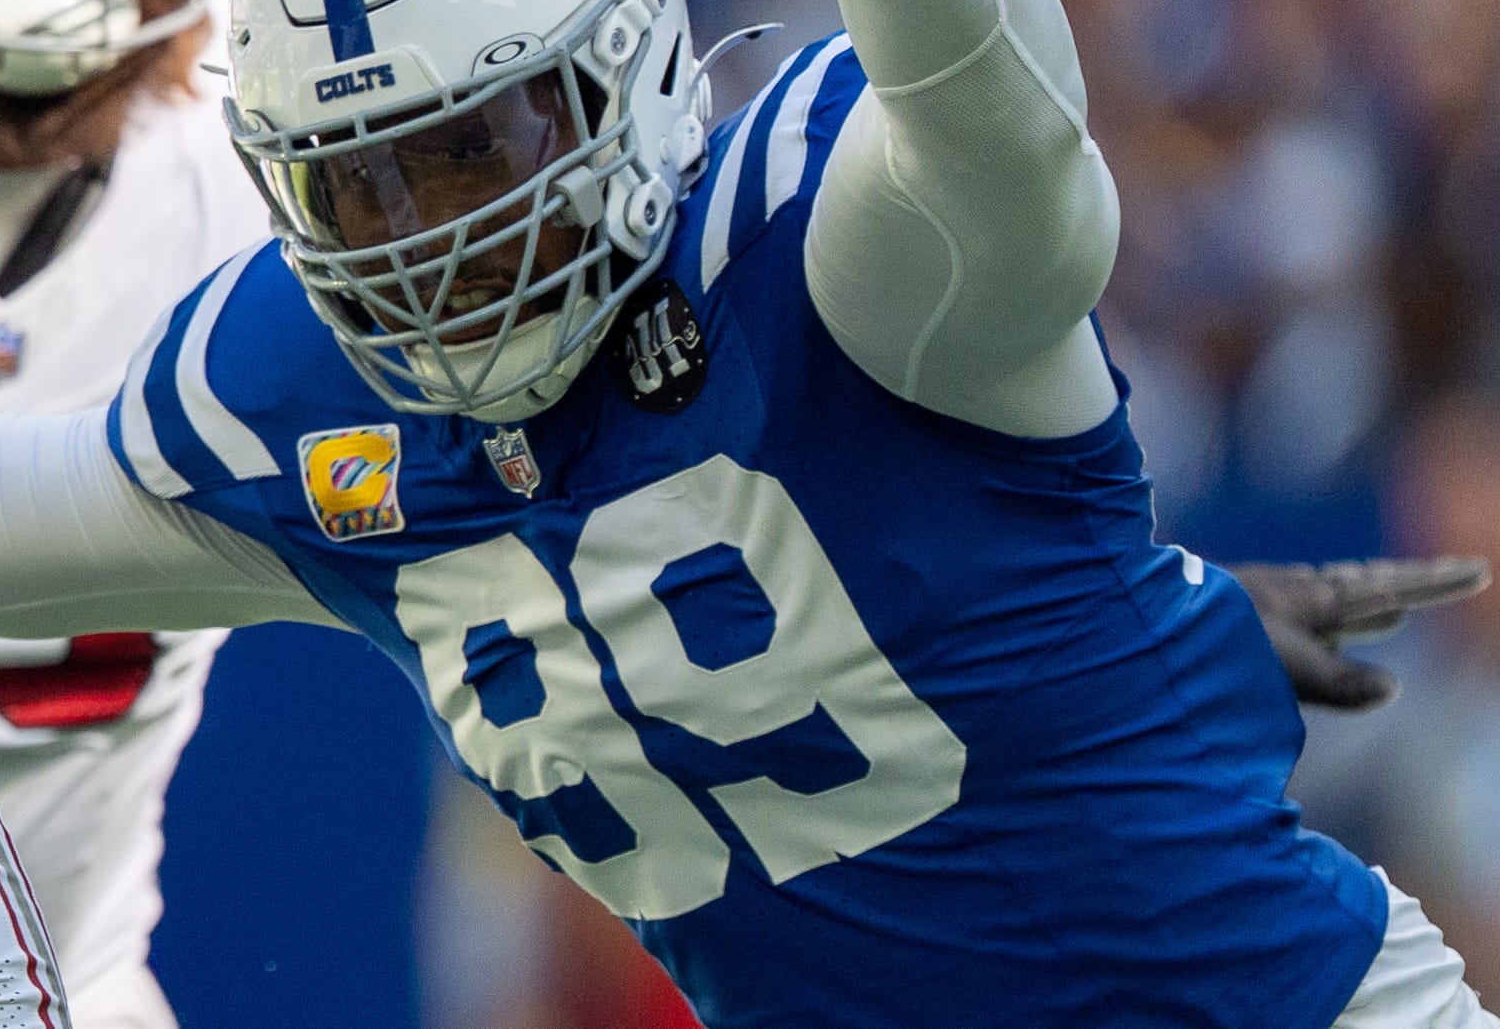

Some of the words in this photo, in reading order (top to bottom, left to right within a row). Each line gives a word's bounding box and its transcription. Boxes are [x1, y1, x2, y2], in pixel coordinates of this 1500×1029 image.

[315, 63, 396, 103] COLTS
[308, 432, 396, 514] C
[394, 452, 968, 921] 99
